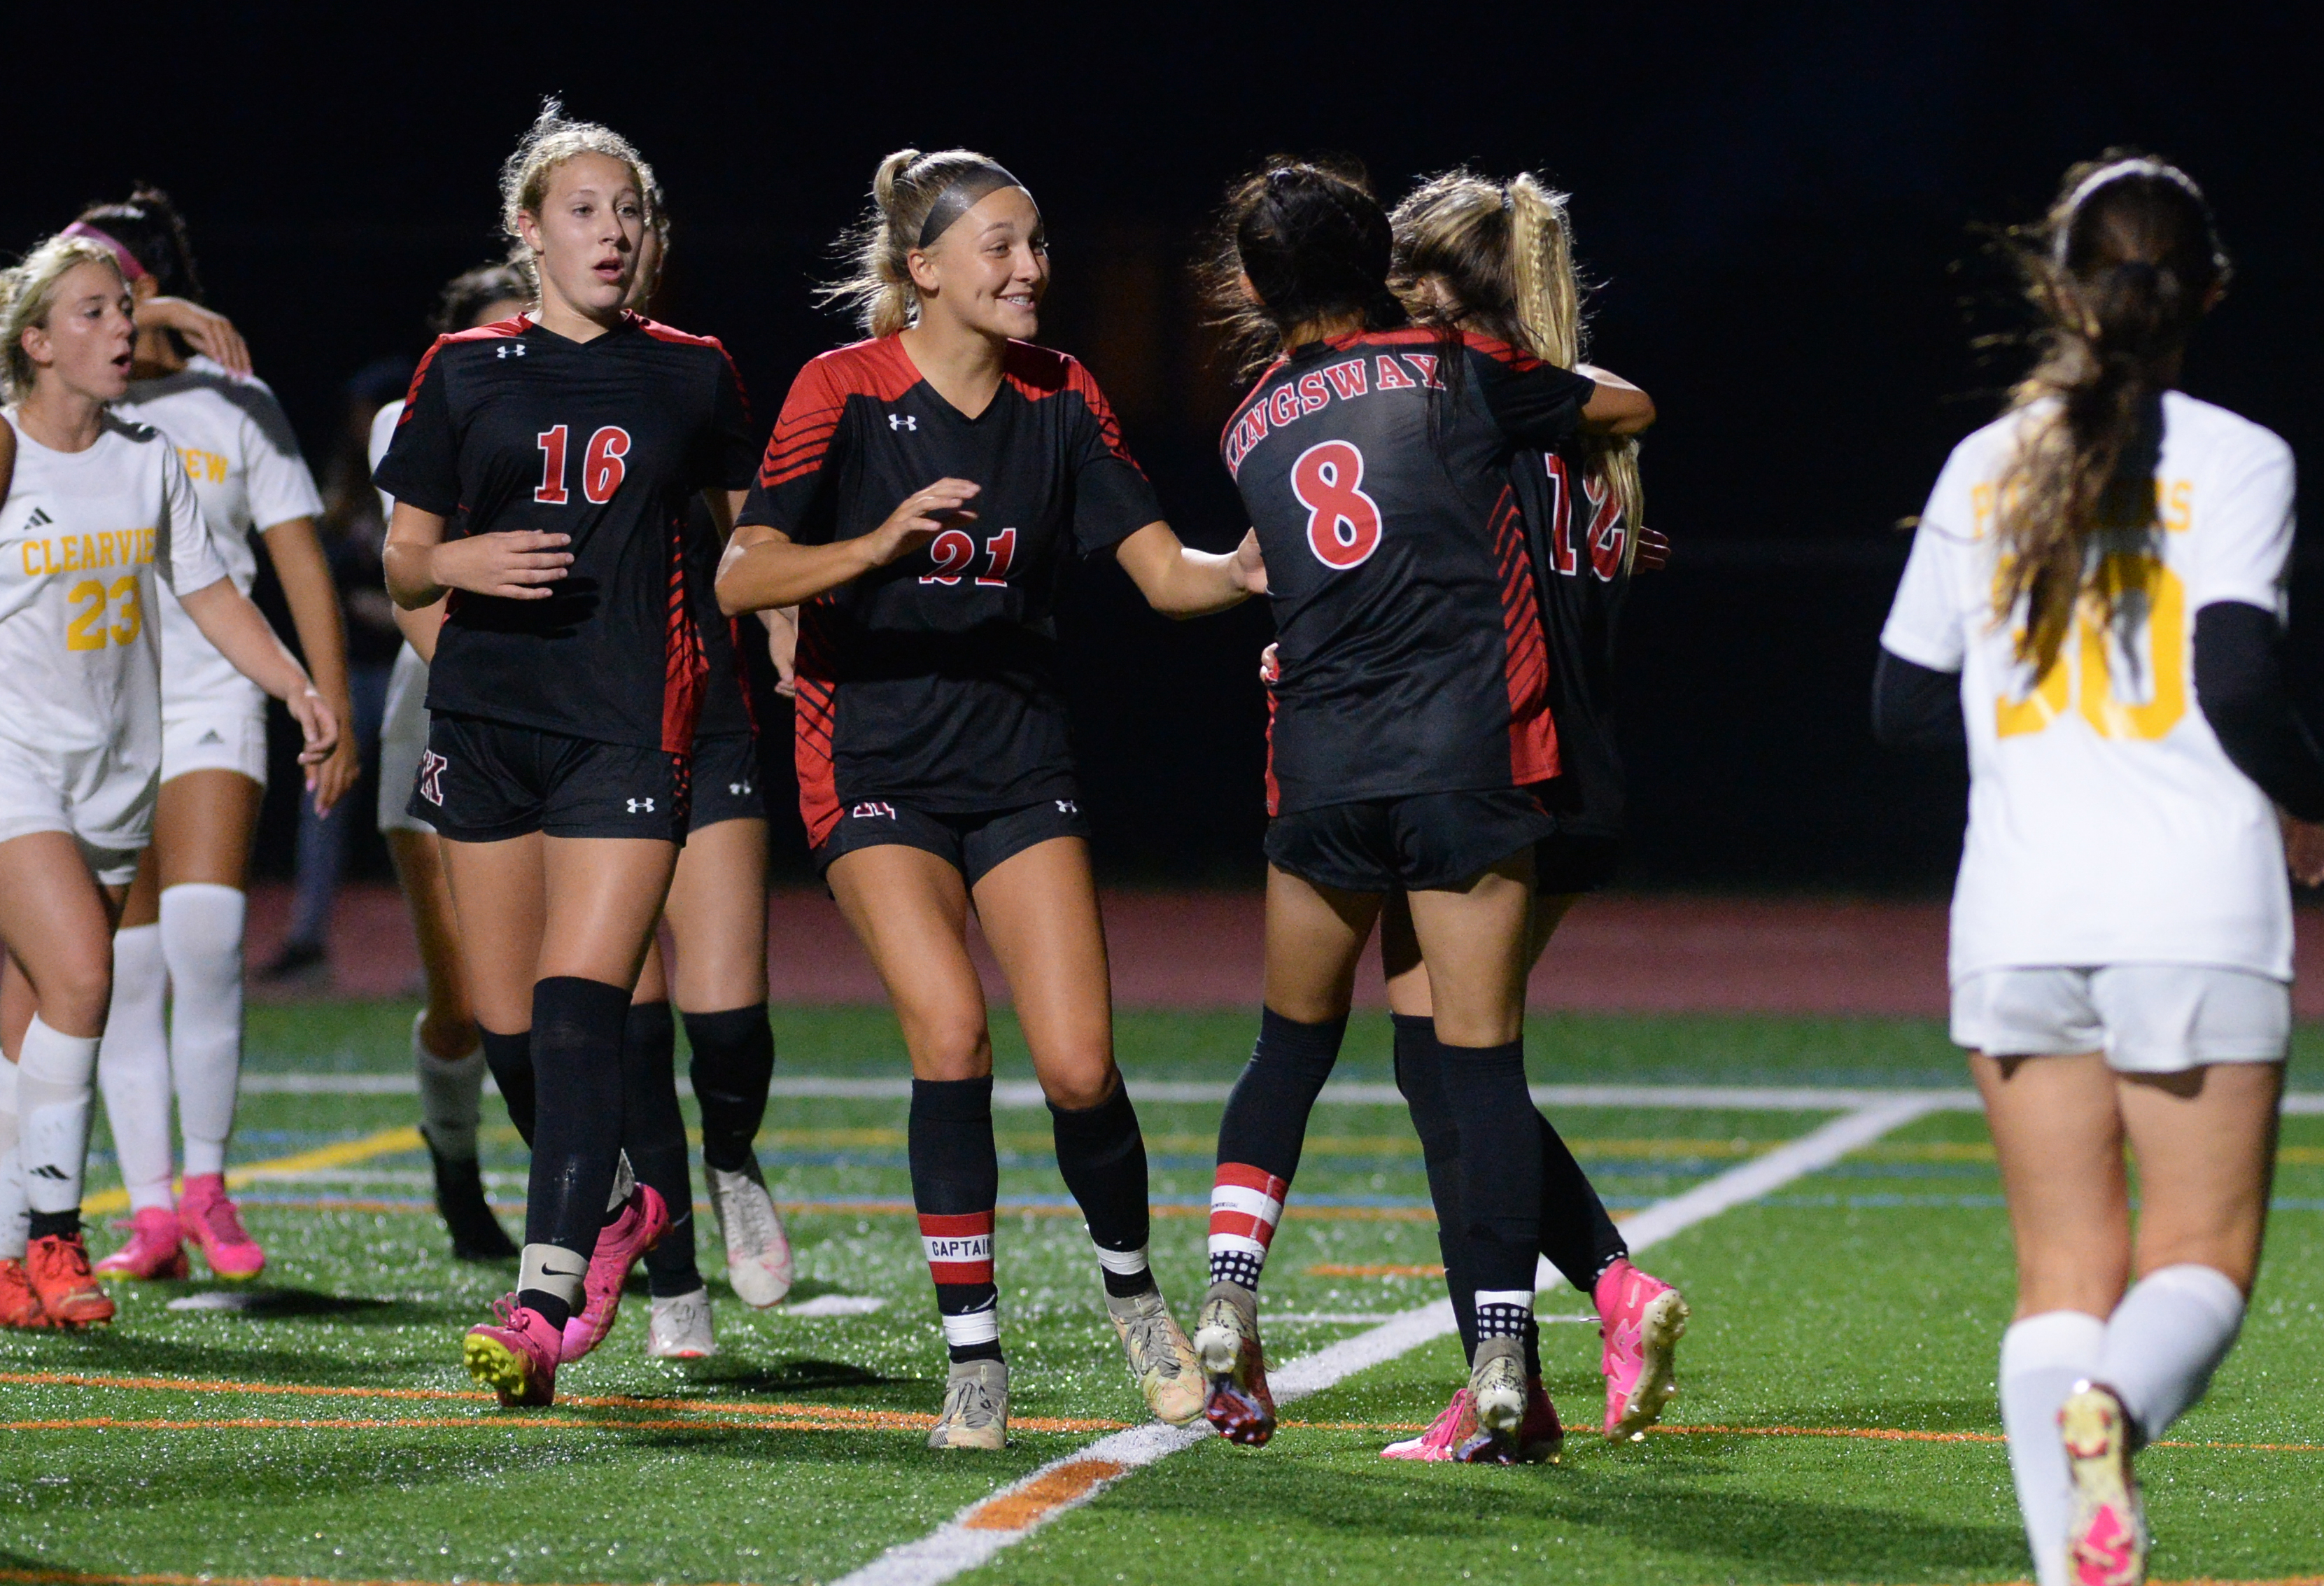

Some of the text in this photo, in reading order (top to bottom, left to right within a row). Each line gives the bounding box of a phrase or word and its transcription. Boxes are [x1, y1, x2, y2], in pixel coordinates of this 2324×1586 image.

[534, 424, 631, 505] 16
[1291, 440, 1382, 570] 8
[1544, 452, 1627, 582] 12
[22, 528, 155, 577] CLEARVIE
[919, 528, 1017, 587] 21
[67, 575, 142, 651] 23
